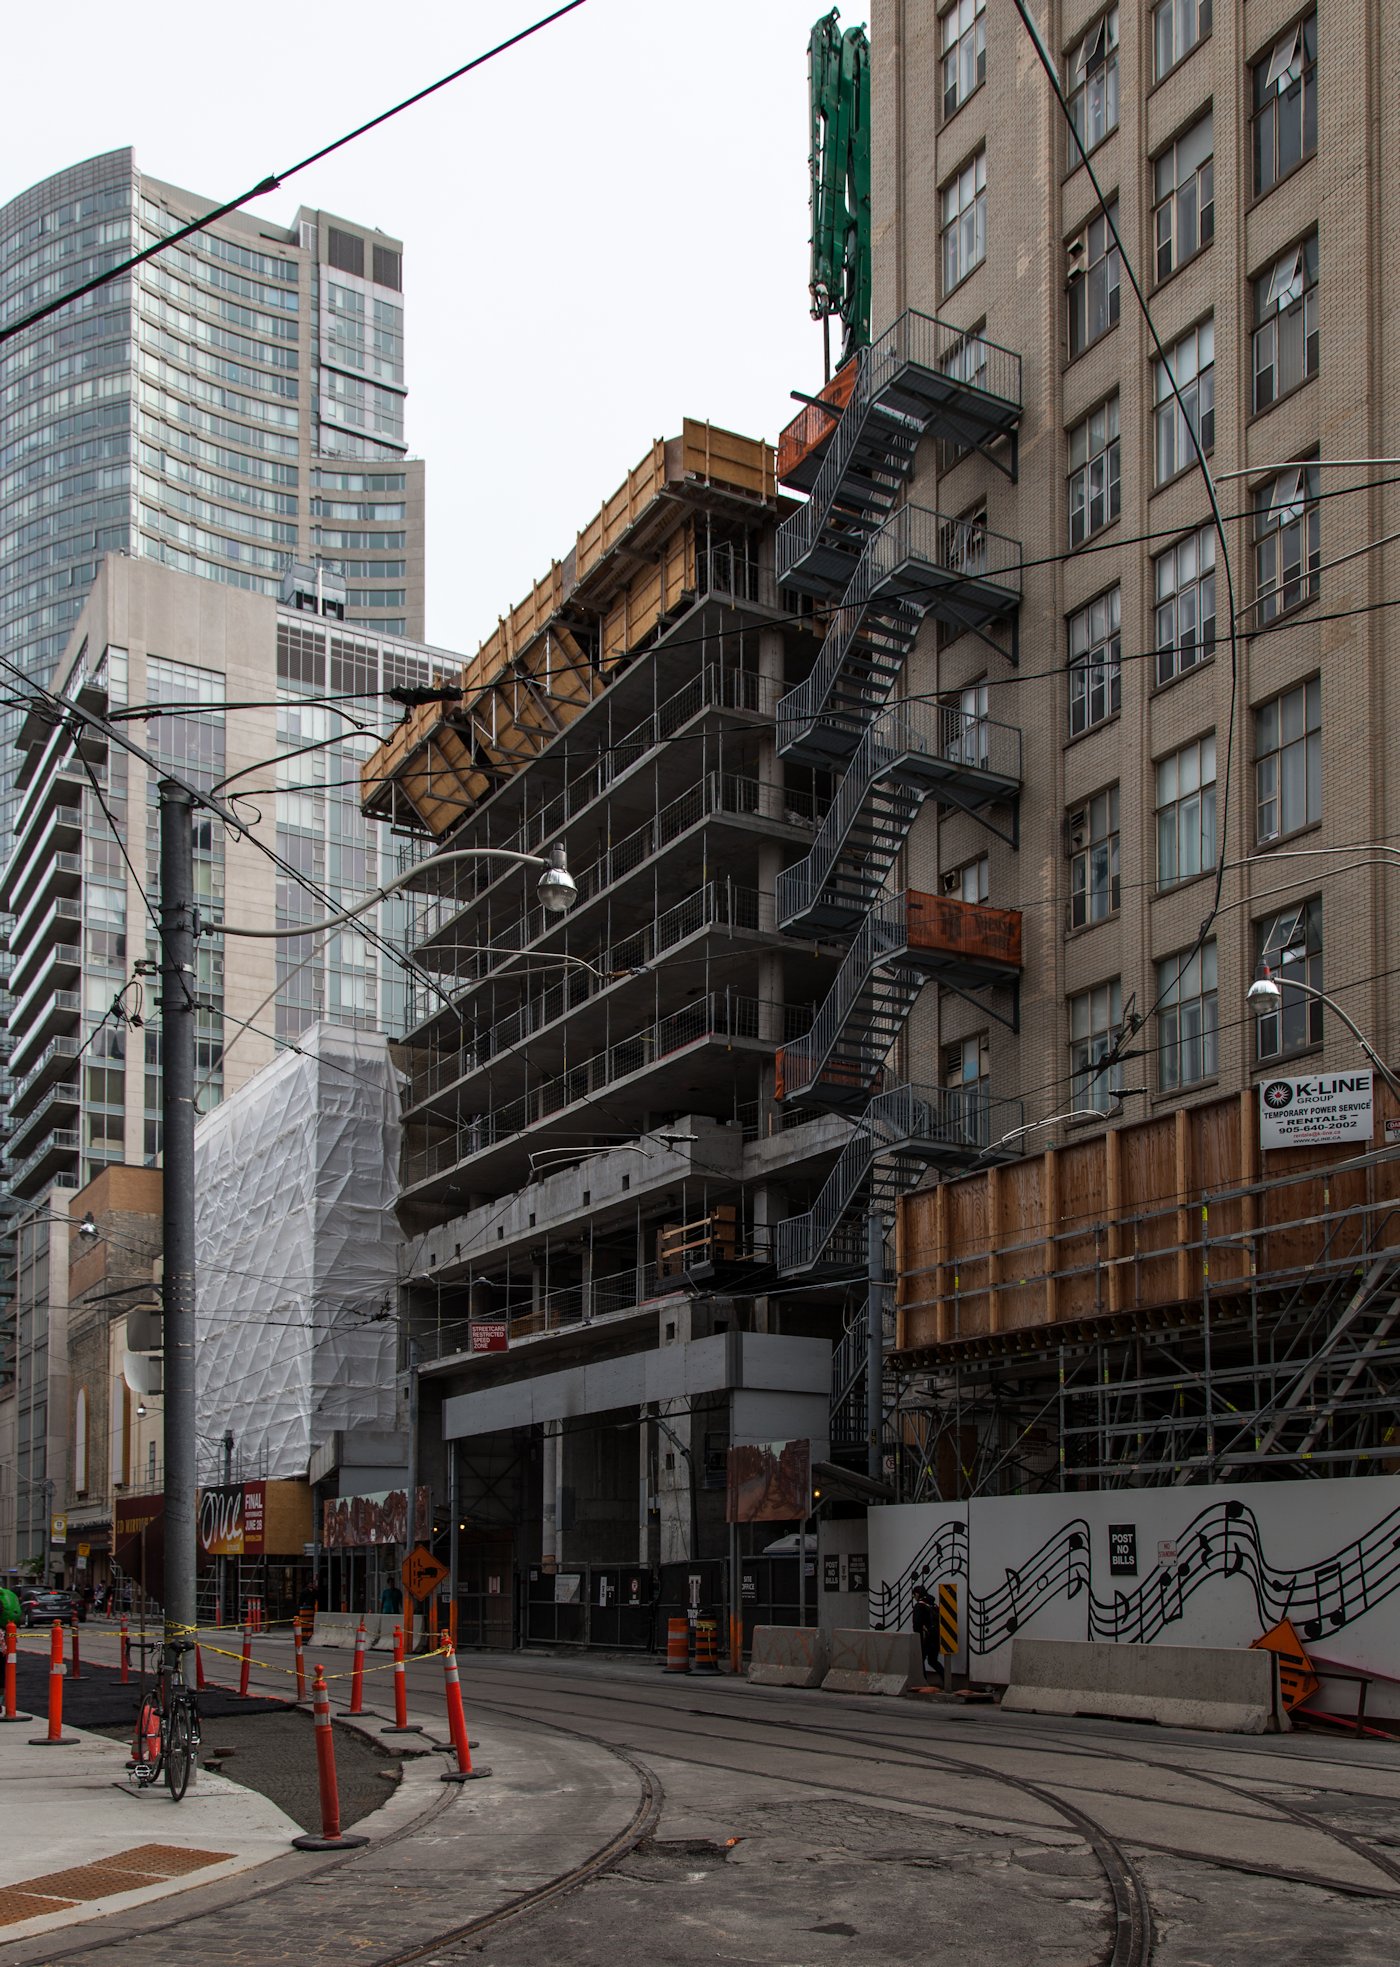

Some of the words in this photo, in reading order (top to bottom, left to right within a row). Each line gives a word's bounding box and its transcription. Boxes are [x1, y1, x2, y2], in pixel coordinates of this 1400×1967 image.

[1296, 1077, 1370, 1097] K-LINE
[1297, 1095, 1334, 1104] GROUP
[1264, 1108, 1308, 1119] TEMPORARY
[1310, 1105, 1337, 1115] POWER
[1338, 1102, 1371, 1112] SERVICE
[1287, 1114, 1347, 1125] RENTALS
[1279, 1121, 1357, 1134] 905-640-2002
[245, 1493, 263, 1510] FINAL
[245, 1520, 256, 1531] JUNE
[1111, 1533, 1134, 1543] POST
[1116, 1545, 1129, 1554] NO
[1112, 1555, 1135, 1565] BILLS
